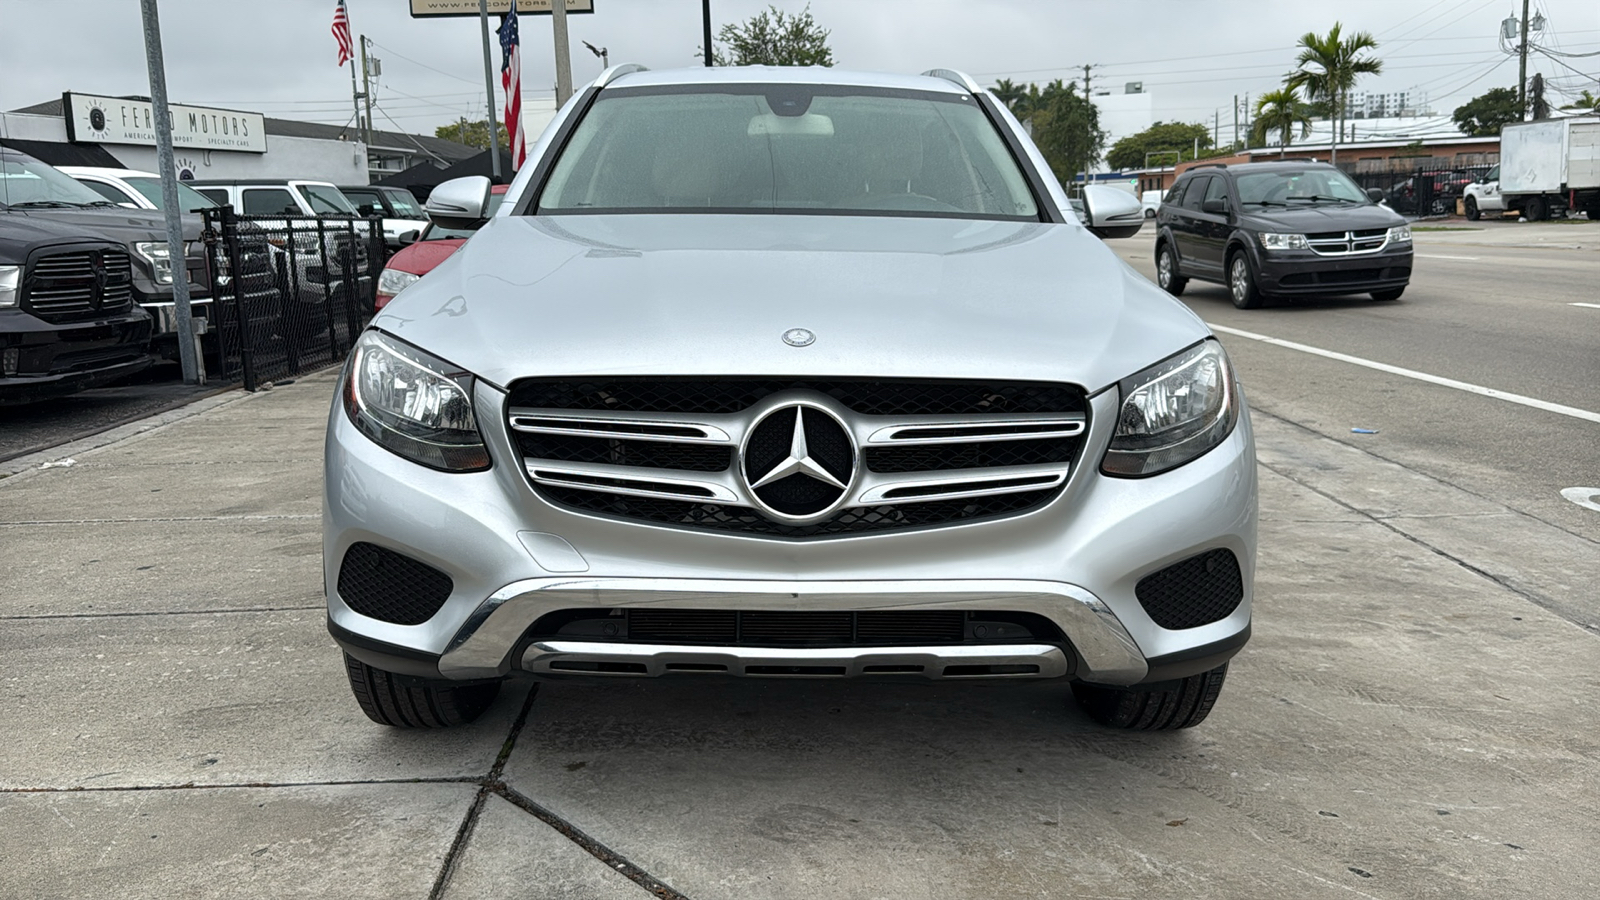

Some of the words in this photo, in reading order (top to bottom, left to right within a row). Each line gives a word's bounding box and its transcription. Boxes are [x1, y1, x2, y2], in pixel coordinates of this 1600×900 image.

[120, 105, 175, 131] FERO
[188, 112, 249, 137] MOTORS
[123, 132, 156, 140] AMERICAN
[173, 135, 193, 143] MPORT
[207, 138, 235, 146] SPECIALTY
